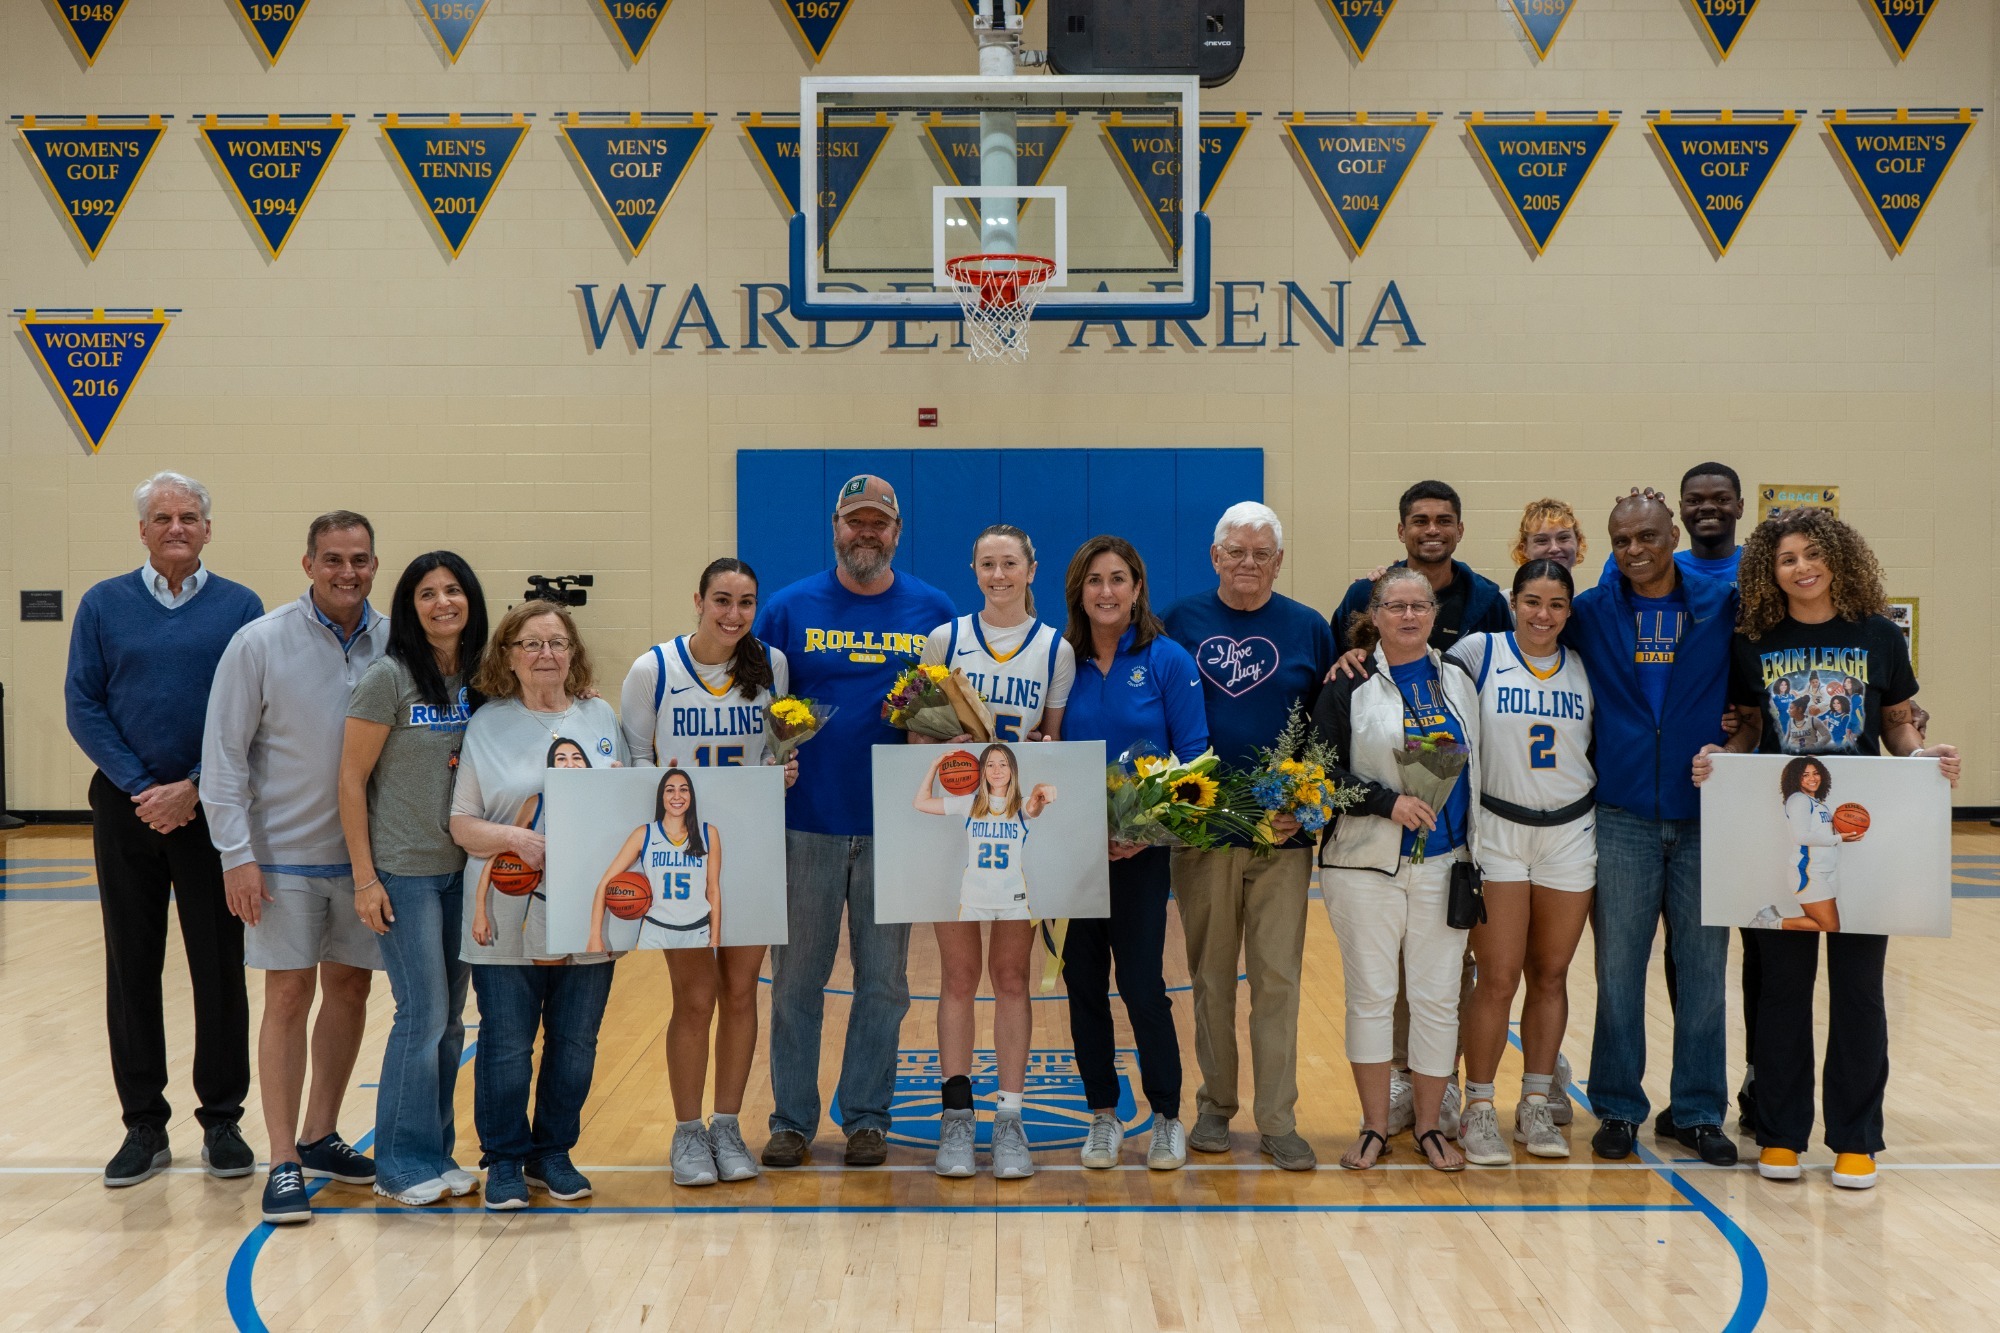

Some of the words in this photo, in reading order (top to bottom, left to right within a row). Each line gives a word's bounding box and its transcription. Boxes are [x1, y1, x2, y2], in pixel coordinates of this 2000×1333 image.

[69, 4, 114, 22] 1948
[250, 4, 295, 22] 1950
[430, 3, 476, 21] 1956
[612, 2, 657, 20] 1966
[795, 2, 840, 19] 1967
[1340, 0, 1384, 17] 1974
[1522, 0, 1566, 16] 1989
[1704, 0, 1748, 16] 1991
[1881, 0, 1926, 16] 1991
[45, 141, 140, 158] WOMEN'S
[227, 141, 322, 157] WOMEN'S
[426, 139, 486, 156] MEN'S
[608, 139, 667, 156] MEN'S
[776, 142, 859, 157] WAERSKI
[952, 142, 1044, 157] WASKI
[1132, 138, 1222, 154] WOMN'S
[1318, 137, 1406, 152] WOMEN'S
[1498, 141, 1587, 156] WOMEN'S
[1681, 140, 1769, 155] WOMEN'S
[1856, 135, 1946, 151] WOMEN'S
[66, 163, 119, 180] GOLF
[248, 162, 301, 179] GOLF
[419, 162, 492, 178] TENNIS
[609, 162, 662, 179] GOLF
[1337, 159, 1387, 174] GOLF
[1517, 162, 1567, 177] GOLF
[1700, 162, 1749, 177] GOLF
[1875, 157, 1925, 173] GOLF
[70, 199, 115, 217] 1992
[251, 199, 297, 216] 1994
[433, 197, 478, 214] 2001
[615, 199, 656, 217] 2002
[1342, 195, 1380, 211] 2004
[1522, 194, 1561, 211] 2005
[1706, 194, 1744, 211] 2006
[1881, 194, 1921, 210] 2008
[45, 332, 146, 349] WOMEN'S
[67, 351, 123, 367] GOLF
[72, 379, 119, 397] 2016
[1778, 491, 1819, 503] GRACE
[804, 628, 930, 657] ROLLINS
[1221, 643, 1252, 668] Love
[1643, 653, 1669, 662] DAD
[1227, 660, 1261, 687] Lucy
[1760, 648, 1806, 689] ERIN
[1809, 647, 1869, 684] LEIGH
[1497, 687, 1584, 721] ROLLINS
[673, 705, 764, 736] ROLLINS
[1528, 722, 1557, 770] 2
[941, 759, 972, 770] Wilson
[973, 822, 1018, 839] ROLLINS
[652, 851, 703, 868] ROLLINS
[978, 842, 1010, 870] 25
[662, 872, 691, 900] 15
